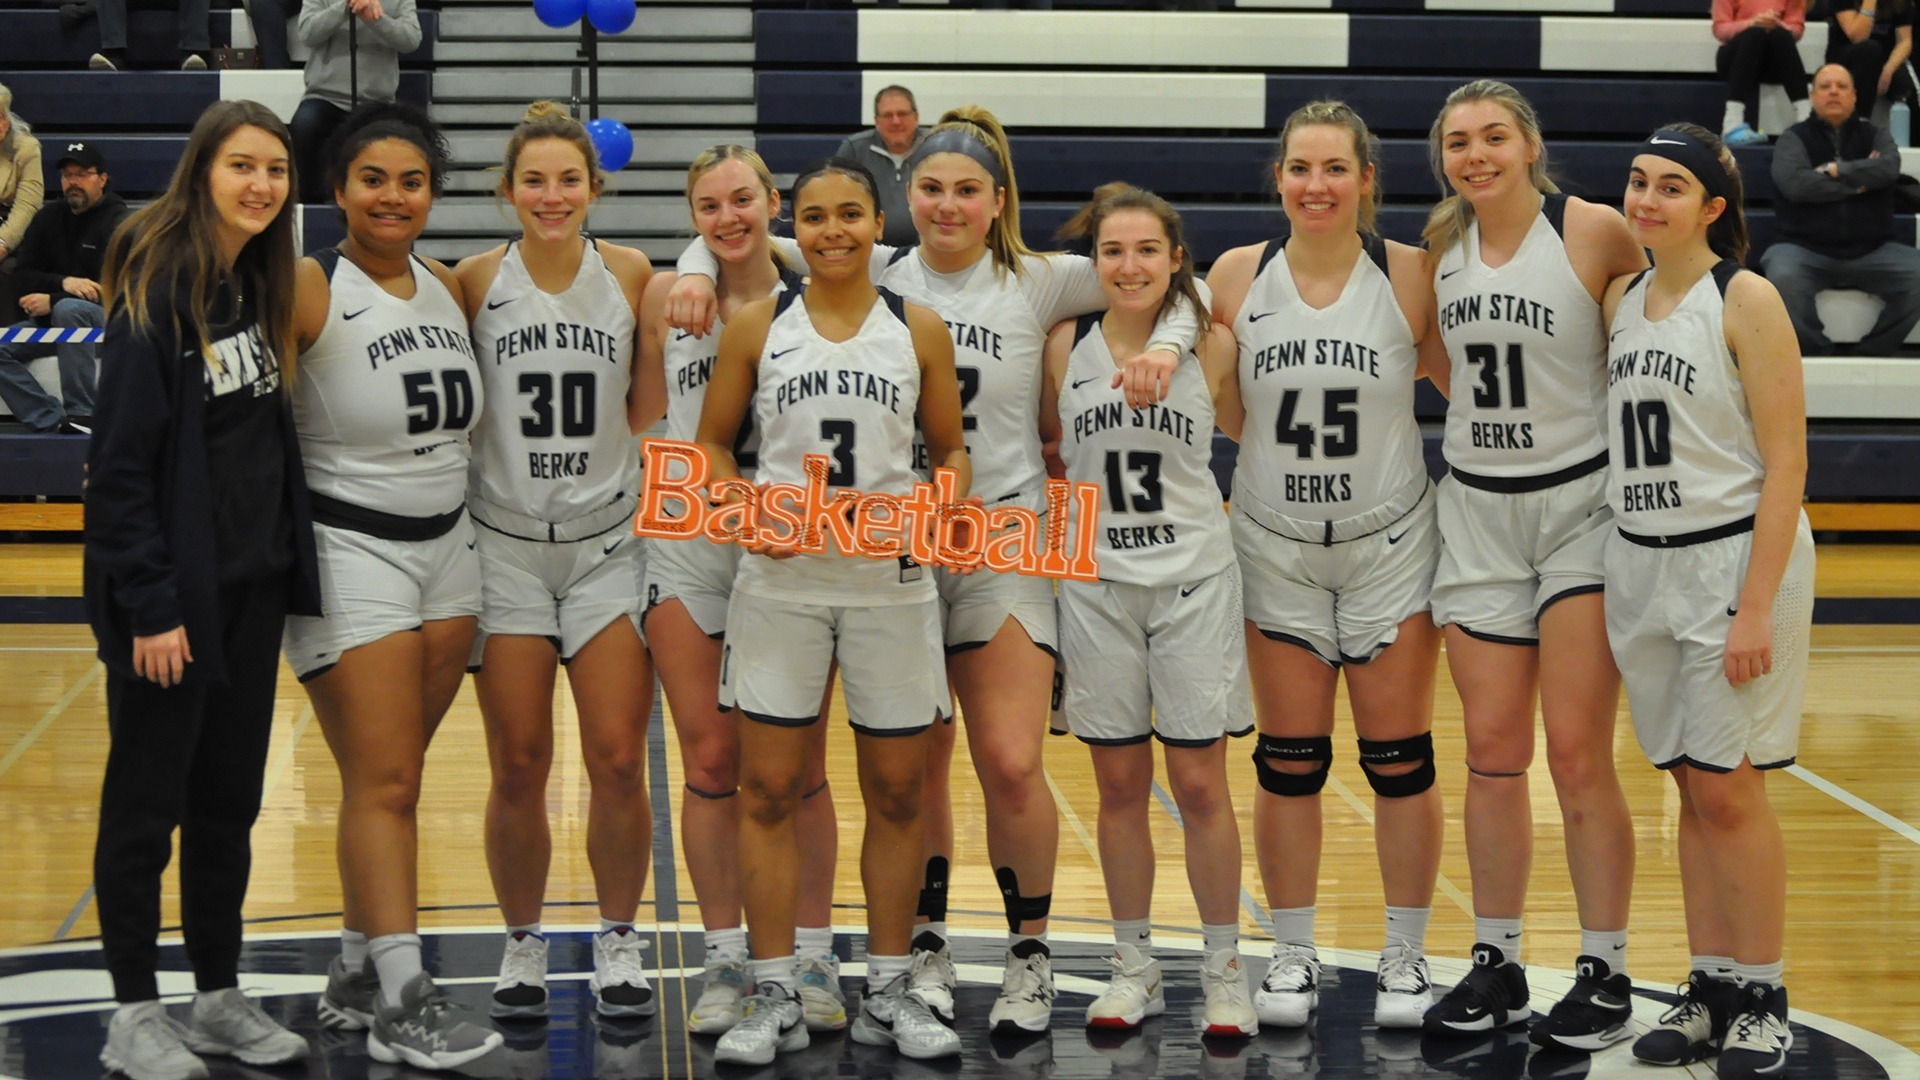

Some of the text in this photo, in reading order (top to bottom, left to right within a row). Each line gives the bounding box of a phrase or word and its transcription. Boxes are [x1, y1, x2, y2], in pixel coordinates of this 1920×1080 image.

[1441, 294, 1555, 338] PENN STATE
[367, 326, 419, 371] PENN
[496, 322, 616, 366] PENN STATE
[945, 321, 1003, 362] TATE
[1254, 338, 1380, 381] PENN STATE
[777, 370, 900, 415] PENN STATE
[1464, 342, 1528, 410] 31
[1608, 350, 1697, 396] ENN STATE
[401, 369, 475, 437] 50
[517, 371, 597, 439] 30
[1075, 402, 1194, 447] PENN STATE
[1275, 387, 1360, 461] 45
[821, 420, 856, 487] 3
[1472, 421, 1534, 450] BERKS
[1620, 400, 1672, 471] 10
[529, 451, 589, 480] BERKS
[1104, 450, 1164, 514] 13
[1285, 473, 1352, 503] BERKS
[633, 437, 1102, 583] Basketball
[1624, 480, 1681, 512] BERKS
[1108, 524, 1176, 549] BERKS
